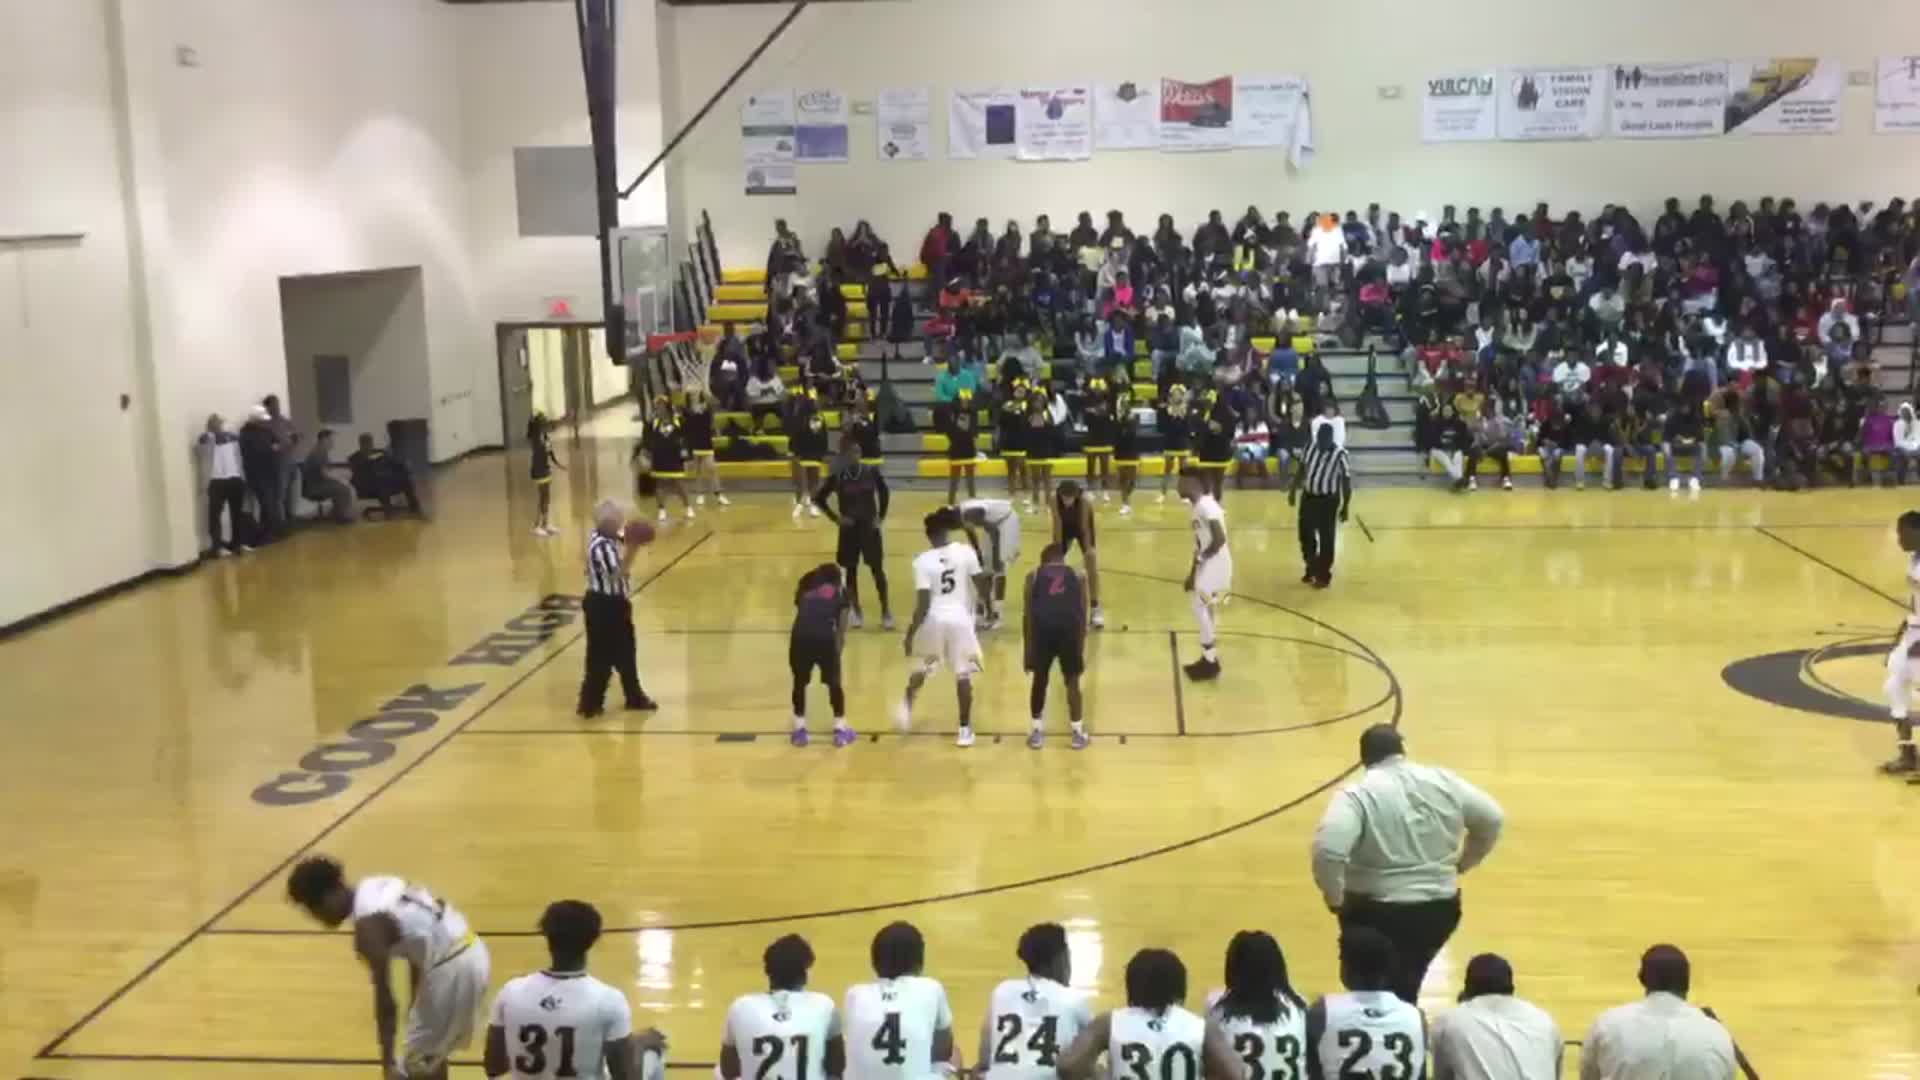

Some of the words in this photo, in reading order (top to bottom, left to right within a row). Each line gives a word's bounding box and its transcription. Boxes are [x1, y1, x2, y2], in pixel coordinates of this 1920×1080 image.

[1428, 77, 1493, 96] VULCAN
[1552, 86, 1591, 95] VISION
[1555, 99, 1585, 108] CARE
[940, 569, 956, 594] 5
[249, 683, 487, 806] COOK
[515, 1023, 578, 1077] 31
[753, 1033, 808, 1080] 21
[871, 1012, 907, 1066] 4
[993, 1012, 1060, 1067] 24
[1119, 1041, 1197, 1080] 30
[1233, 1031, 1300, 1080] 33
[1337, 1028, 1414, 1080] 23
